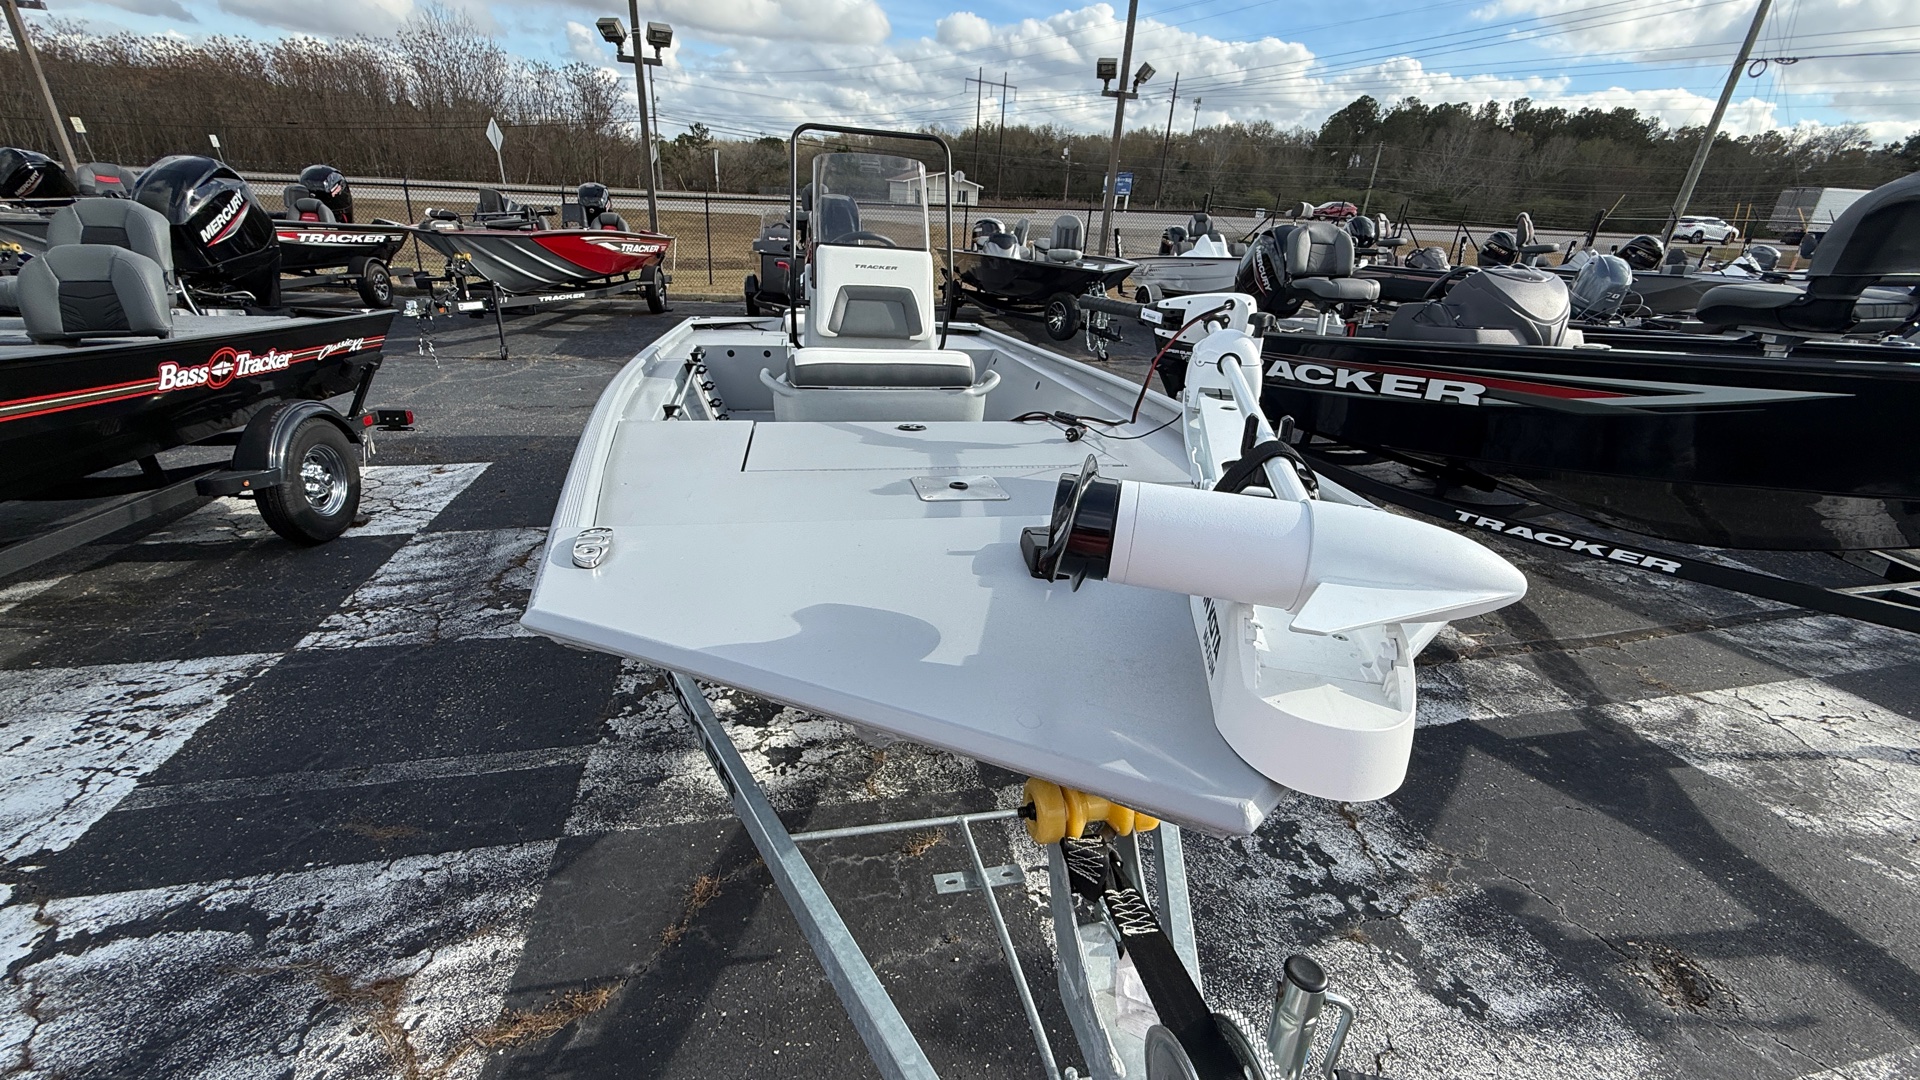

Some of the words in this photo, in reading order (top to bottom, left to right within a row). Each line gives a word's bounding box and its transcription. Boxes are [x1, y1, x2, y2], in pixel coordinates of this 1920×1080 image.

[14, 169, 40, 197] MERCURY
[200, 188, 244, 243] MERCURY
[297, 232, 386, 244] TRACKER
[620, 243, 660, 253] TRACKER
[854, 263, 899, 271] TRACKER
[1255, 244, 1273, 292] MERCURY
[538, 292, 586, 303] TRACKER
[158, 363, 209, 391] Bass
[236, 350, 293, 377] Tracker
[1263, 359, 1487, 407] ACKER
[1454, 509, 1683, 574] TRACKER
